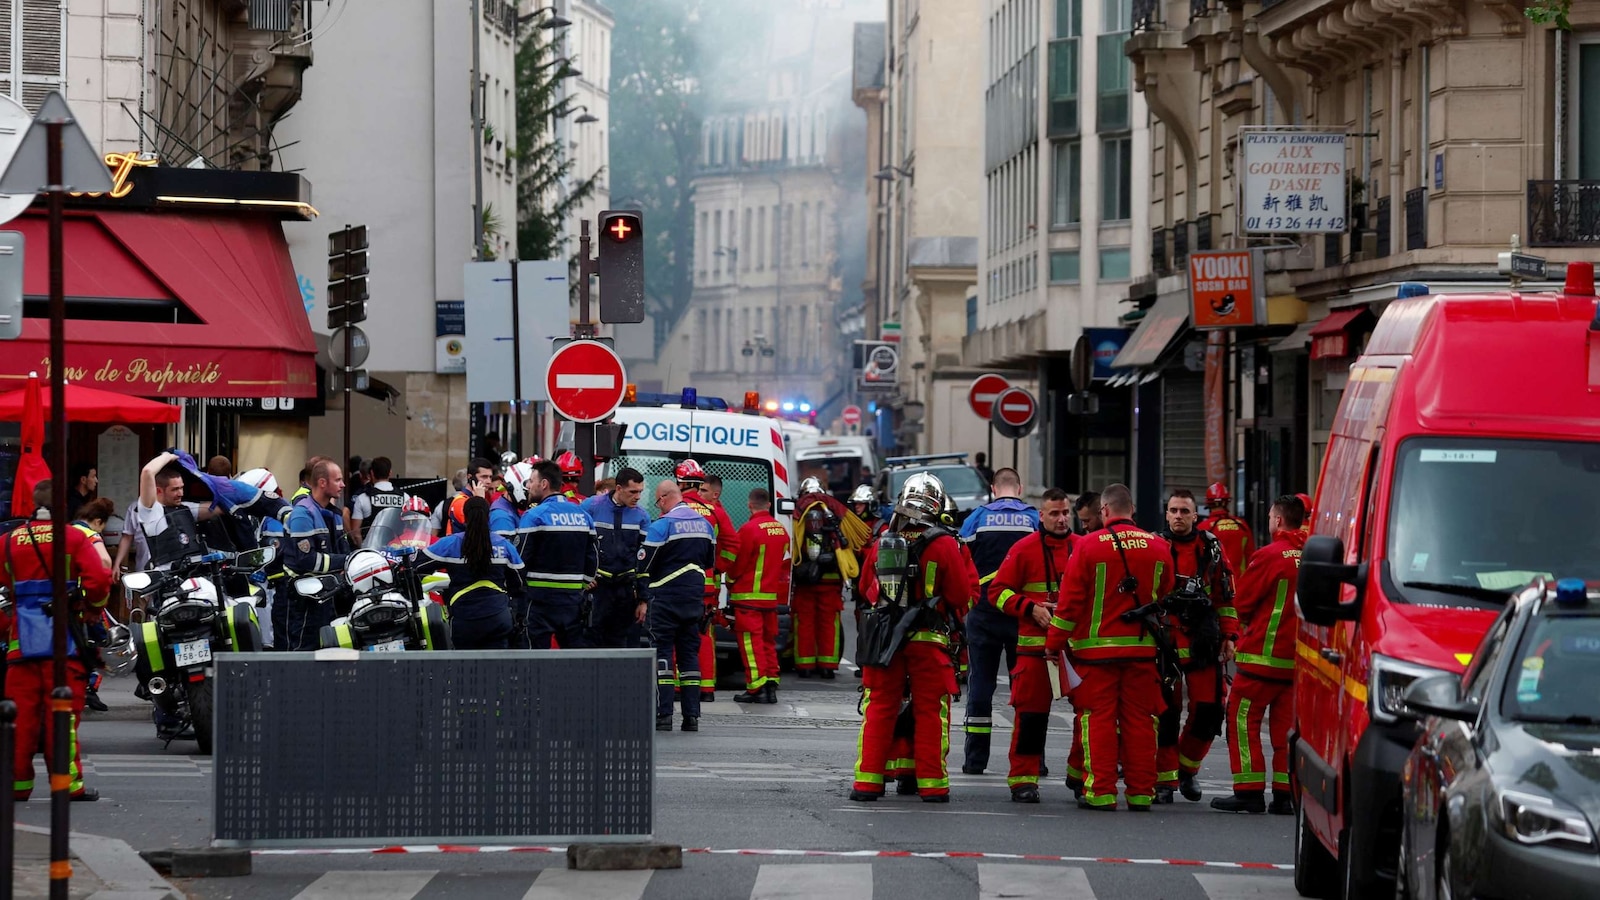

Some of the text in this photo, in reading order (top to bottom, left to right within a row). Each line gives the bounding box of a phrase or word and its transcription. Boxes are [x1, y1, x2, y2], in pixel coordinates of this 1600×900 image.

[1247, 135, 1344, 144] PLATS A EMPORTER
[1277, 145, 1314, 158] AUX
[1248, 162, 1341, 175] GOURMETS
[1269, 178, 1322, 191] D'ASIE
[1247, 216, 1344, 229] 01 43 26 44 42
[1192, 255, 1249, 280] YOOKI
[1196, 279, 1248, 292] SUSHI BAR
[94, 359, 122, 382] de
[622, 421, 760, 447] OGISTIQUE
[373, 495, 402, 506] POLICE
[551, 512, 587, 527] POLICE
[986, 513, 1031, 527] POLICE
[674, 521, 709, 534] POLICE
[767, 528, 785, 536] PARIS
[17, 532, 53, 546] PARIS
[1099, 530, 1126, 542] SAPERS
[1112, 538, 1148, 551] PARIS
